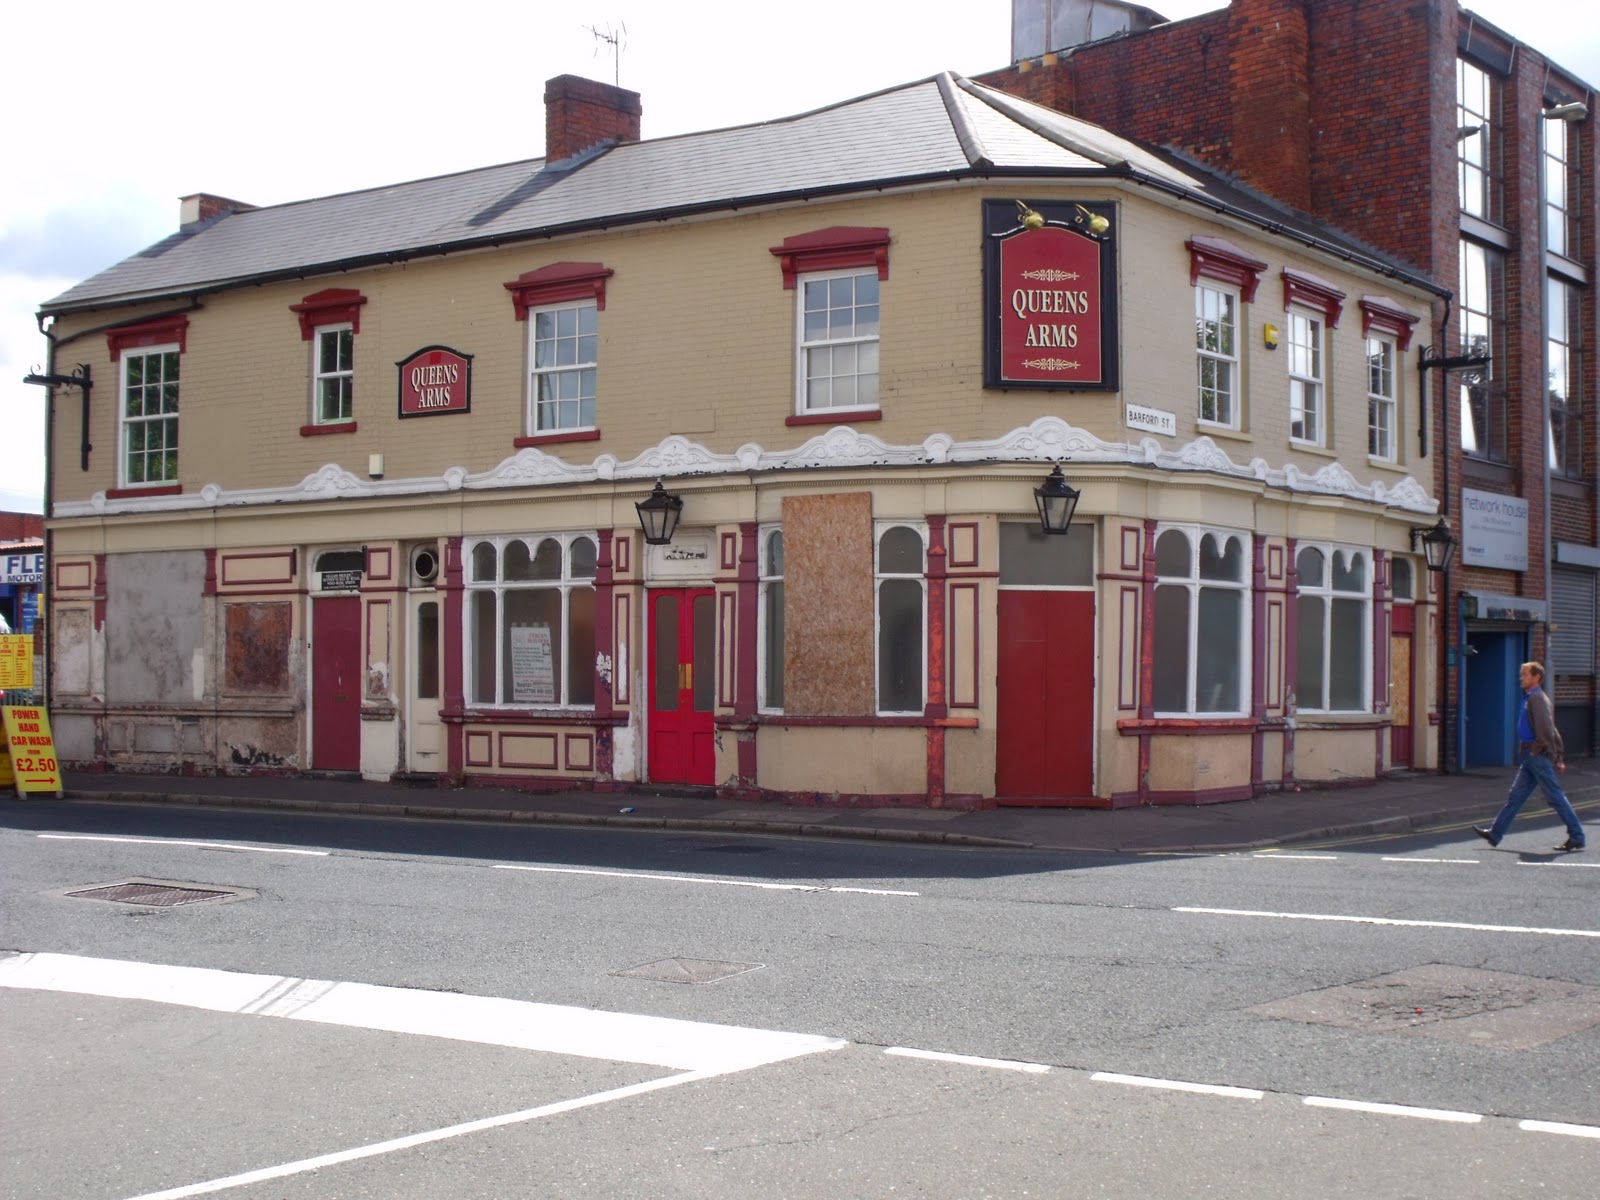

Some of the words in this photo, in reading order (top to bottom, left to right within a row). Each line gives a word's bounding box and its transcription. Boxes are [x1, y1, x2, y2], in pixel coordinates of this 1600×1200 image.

[1012, 288, 1089, 319] QUEENS
[1025, 324, 1078, 348] ARMS
[411, 364, 458, 392] QUEENS
[418, 386, 450, 408] ARMS
[1128, 410, 1159, 425] BARFORD
[1464, 496, 1500, 514] network
[1502, 500, 1527, 519] house
[12, 709, 40, 719] POWER
[18, 722, 39, 733] HAND
[11, 735, 27, 746] CAR
[28, 736, 52, 746] WASH
[16, 758, 56, 772] £2.50
